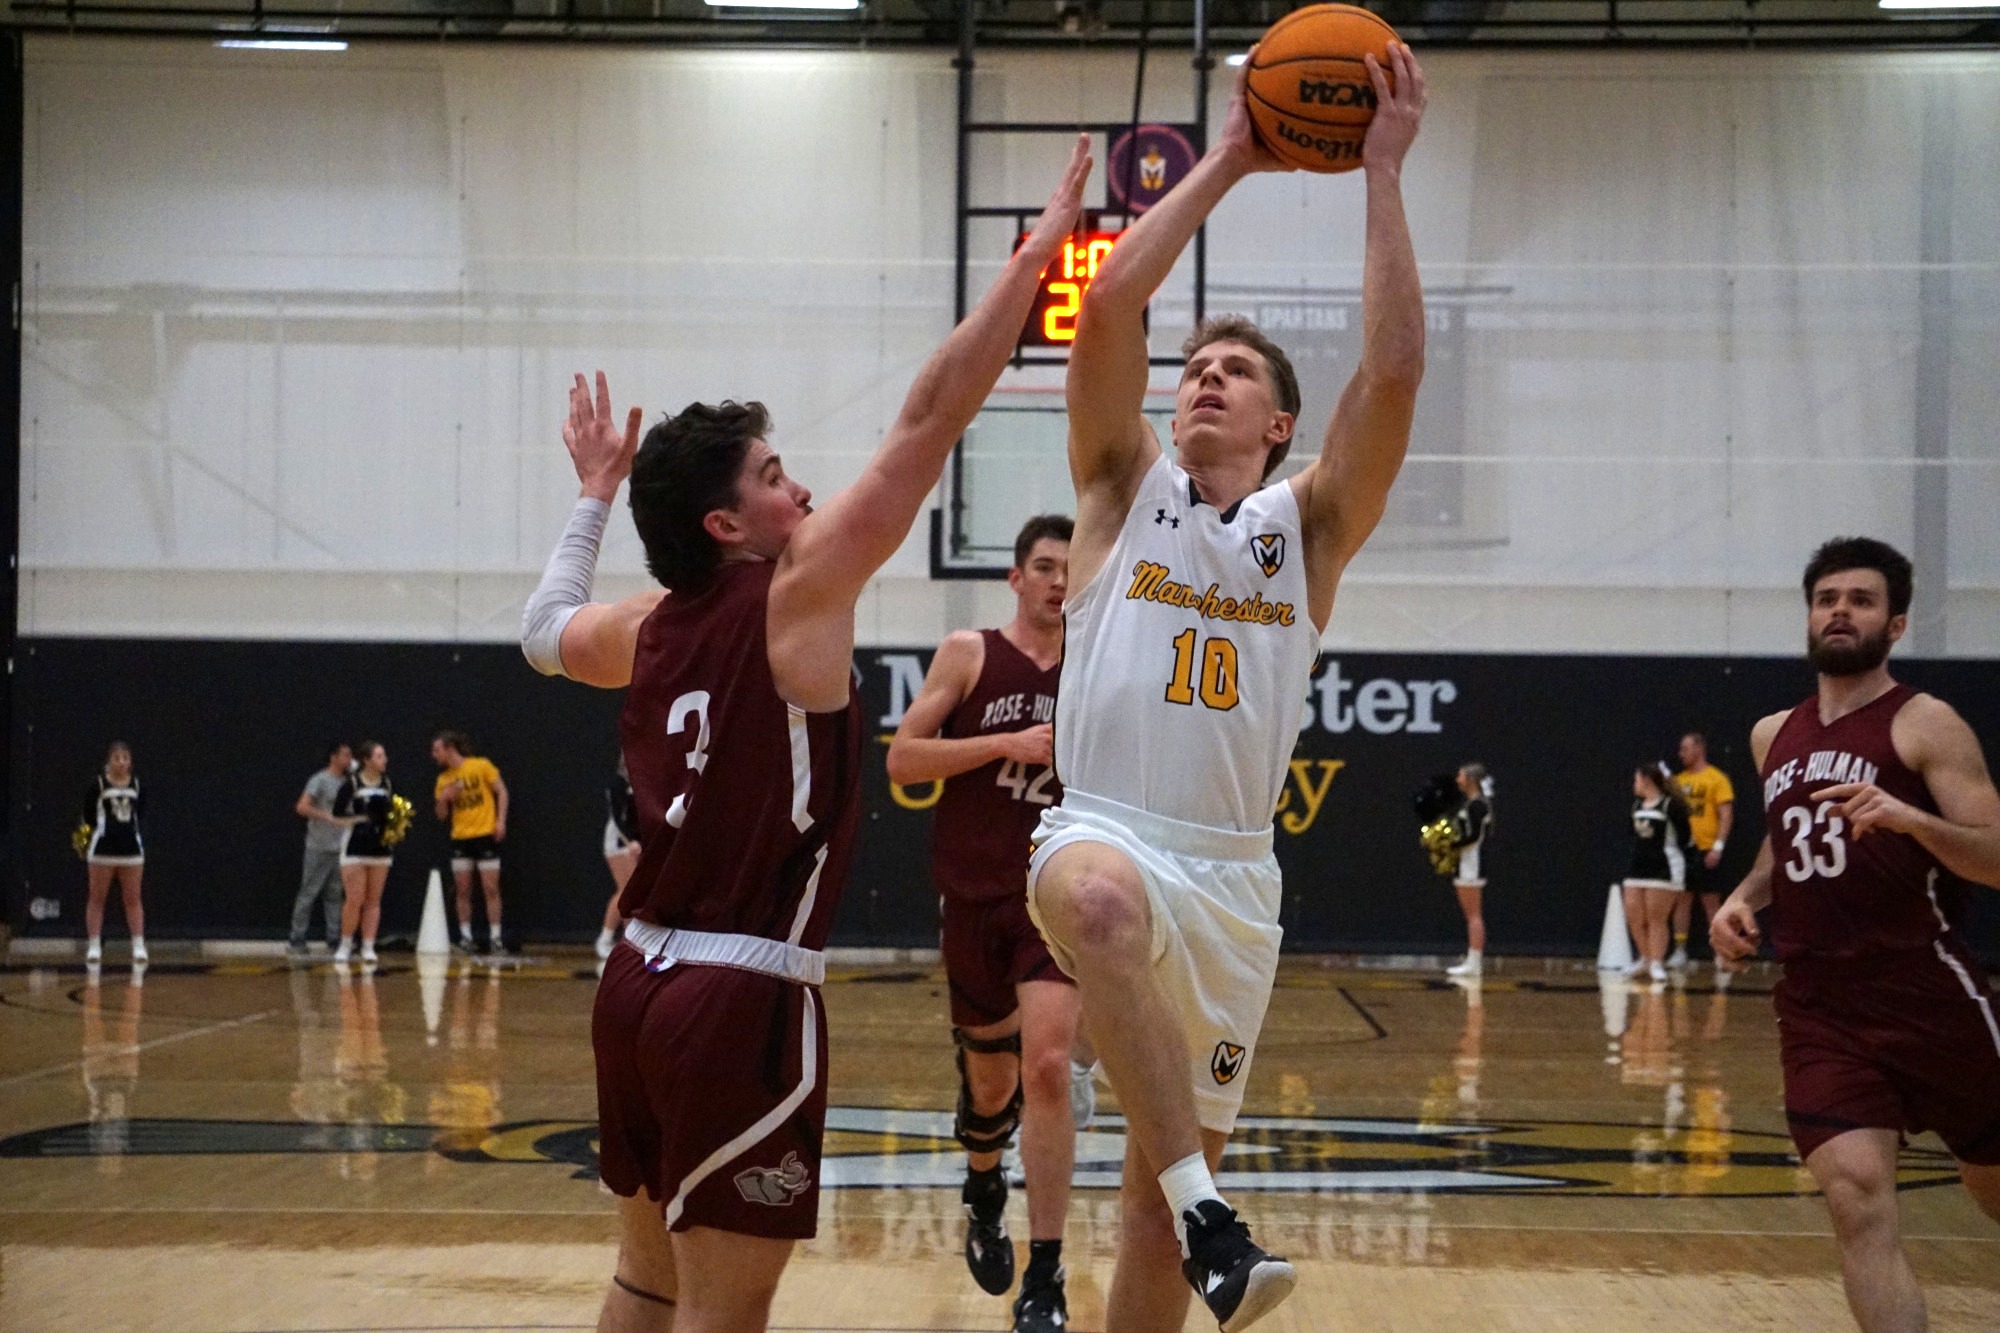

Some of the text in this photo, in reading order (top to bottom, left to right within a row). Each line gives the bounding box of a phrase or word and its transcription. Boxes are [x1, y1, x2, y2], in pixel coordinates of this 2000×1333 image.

[1277, 120, 1364, 159] ilson
[1045, 283, 1080, 340] 2
[1164, 628, 1240, 711] 10
[665, 690, 711, 829] 3
[1782, 800, 1846, 882] 33
